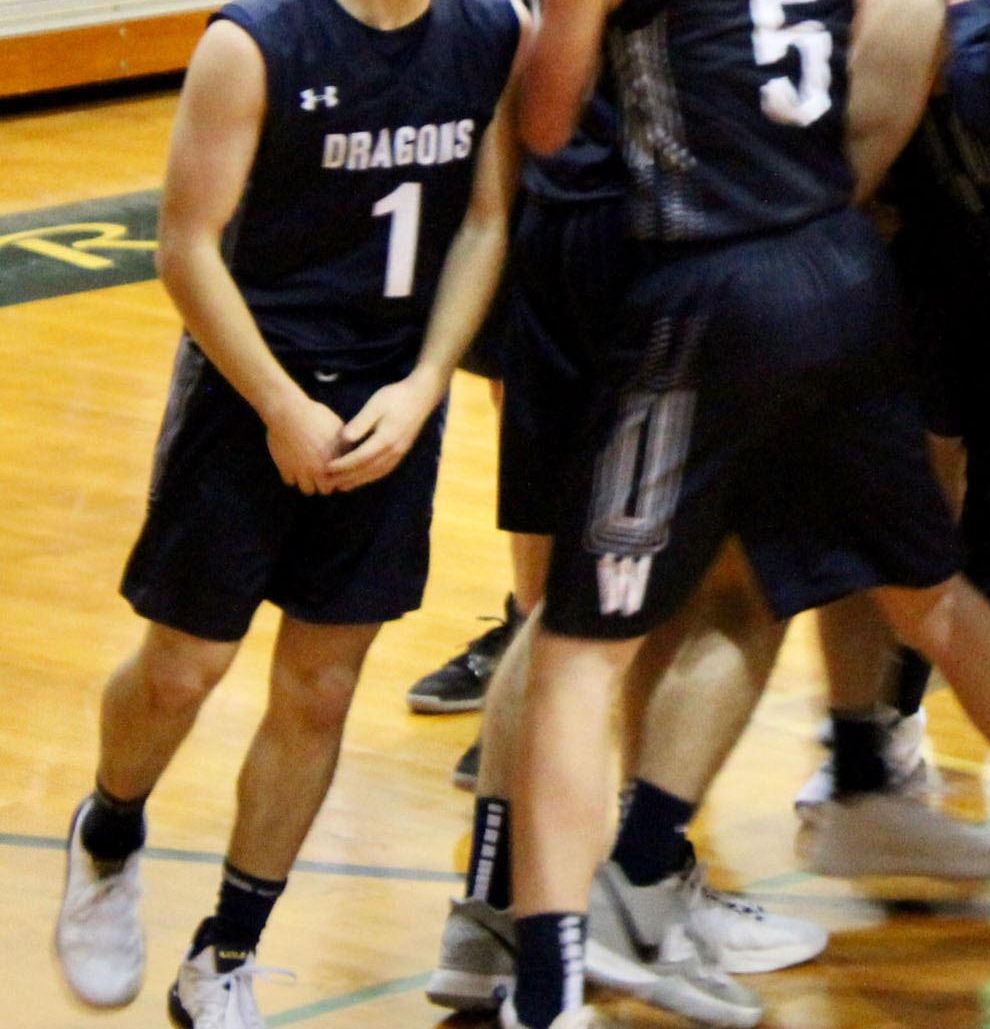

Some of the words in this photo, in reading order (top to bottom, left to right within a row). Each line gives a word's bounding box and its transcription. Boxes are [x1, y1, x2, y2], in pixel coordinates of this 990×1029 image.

[321, 118, 475, 170] DRAGONS
[371, 182, 423, 298] 1
[596, 553, 652, 617] W
